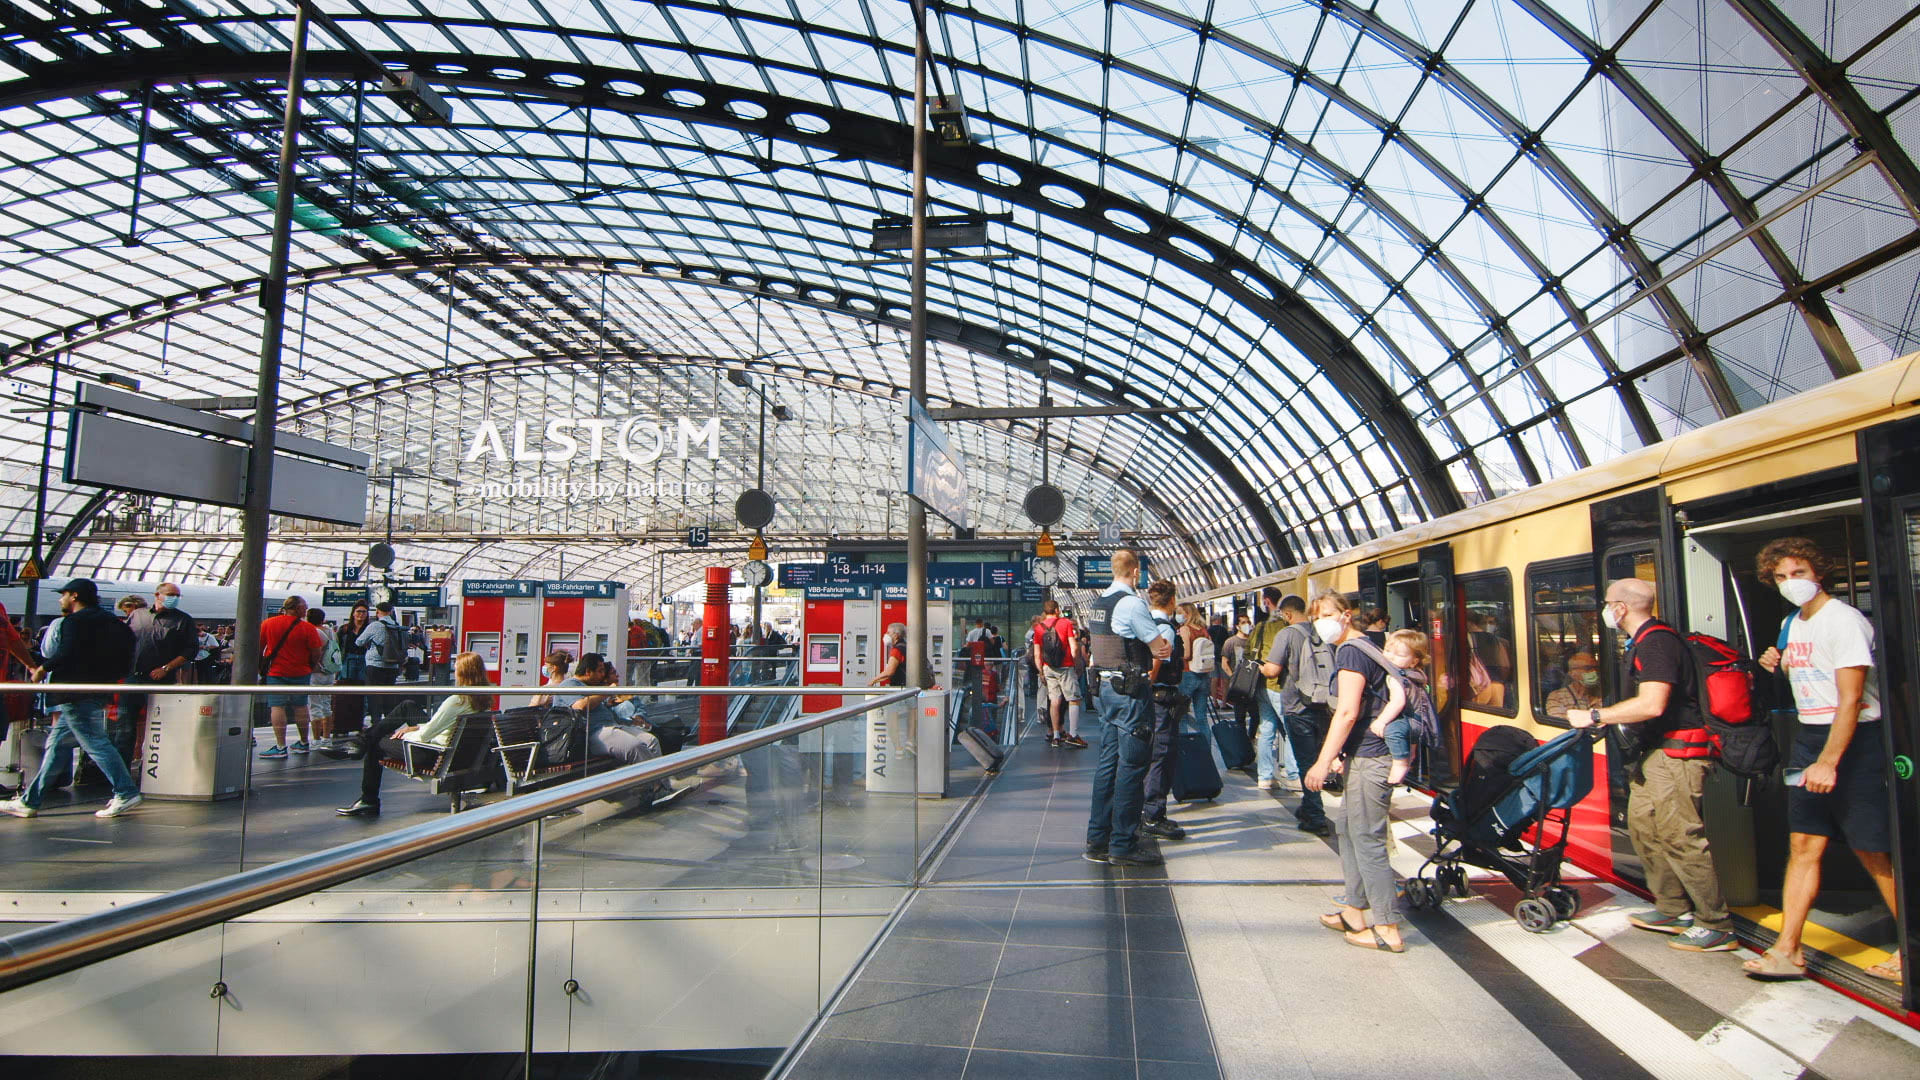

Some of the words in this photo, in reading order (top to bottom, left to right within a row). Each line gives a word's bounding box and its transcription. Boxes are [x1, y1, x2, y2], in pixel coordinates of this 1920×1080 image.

[464, 413, 721, 465] ALSTOM
[690, 527, 707, 543] 15
[1101, 523, 1121, 540] 16
[344, 567, 355, 577] 13
[418, 567, 428, 577] 14
[833, 564, 850, 575] 1-8
[860, 564, 886, 575] 11-14
[466, 582, 515, 590] VBB-Fahrkarten
[547, 583, 595, 591] VBB-Fahrkarten
[147, 721, 161, 779] Abfall
[873, 722, 887, 778] Abfall
